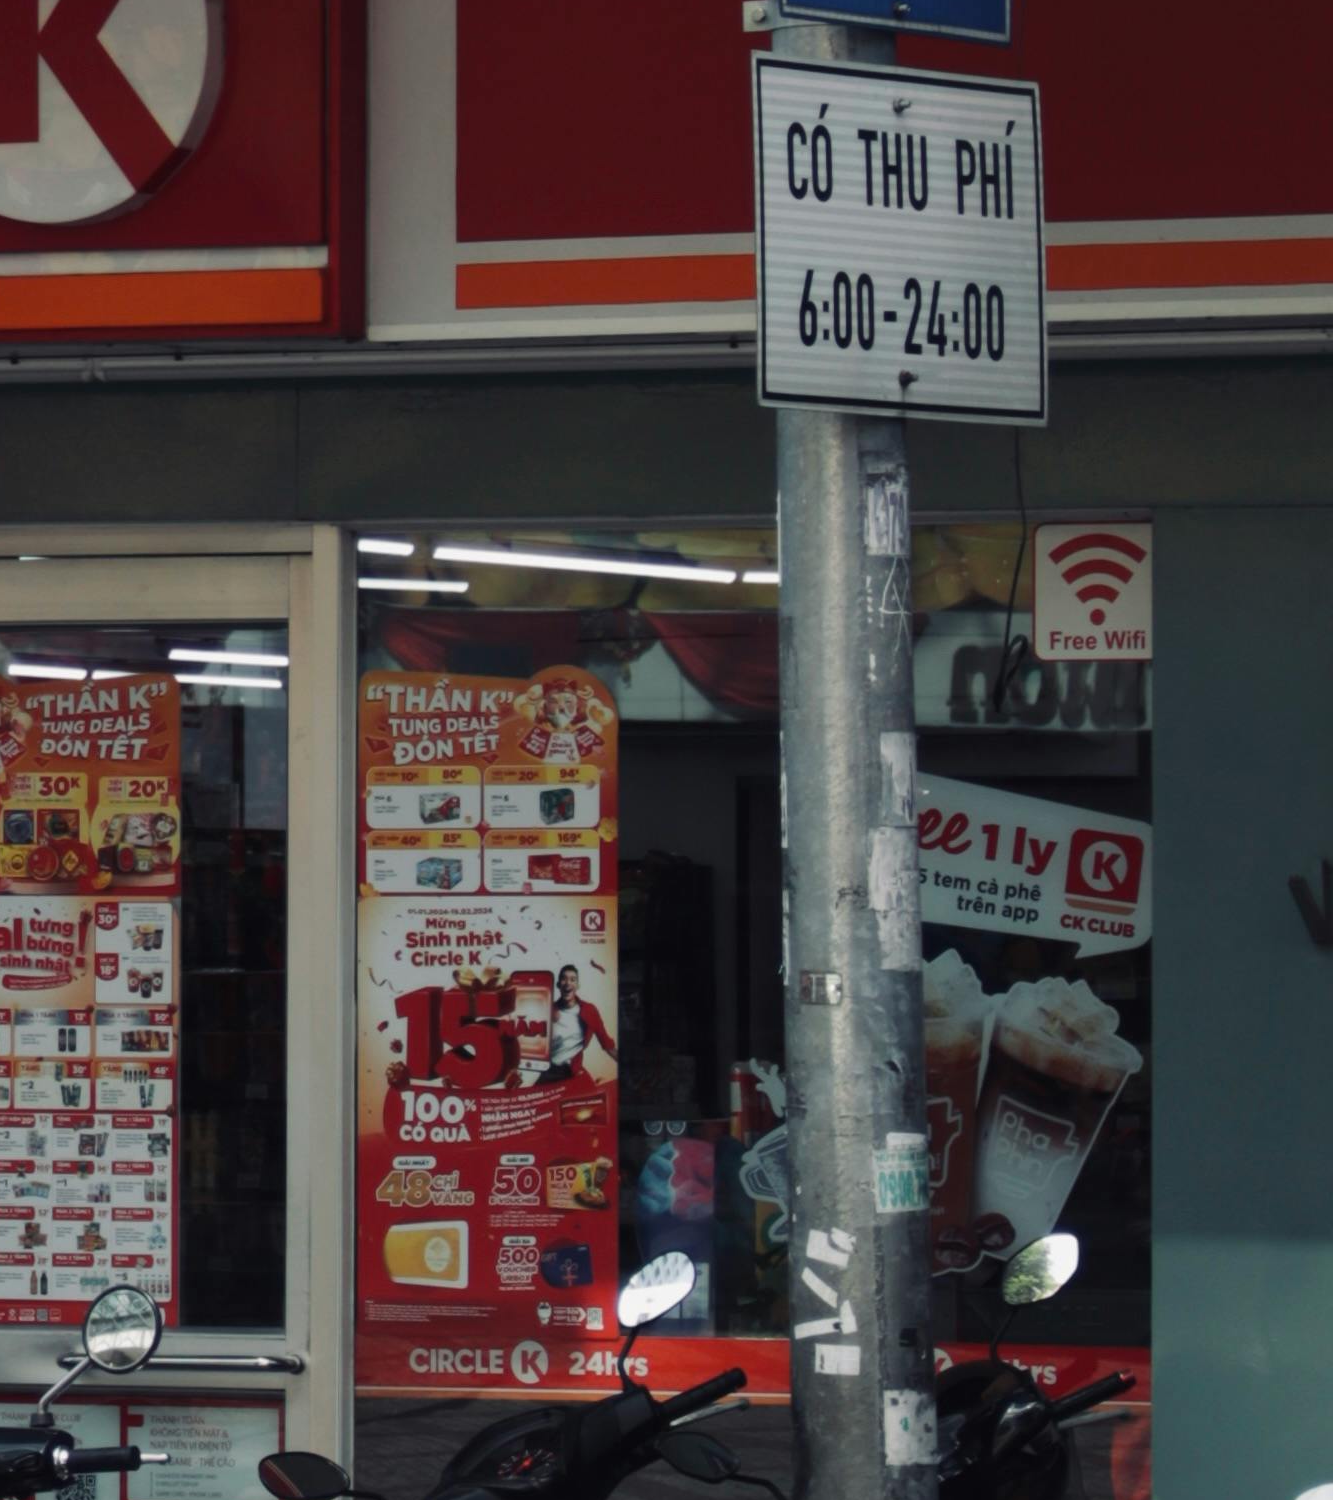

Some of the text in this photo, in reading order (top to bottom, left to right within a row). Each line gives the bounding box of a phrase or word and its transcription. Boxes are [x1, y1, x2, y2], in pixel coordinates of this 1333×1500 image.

[786, 102, 1017, 220] CÓ THU PHÍ
[797, 267, 1007, 363] 6:00-24:00
[1049, 629, 1147, 651] Free Wifi
[41, 712, 151, 735] TUNG DEALS
[388, 714, 500, 738] TUNG DEALS
[40, 725, 149, 760] ĐÓN TẾT
[393, 737, 455, 765] ĐÓN
[459, 727, 501, 755] TẾT
[38, 776, 81, 797] 30K
[127, 780, 166, 798] 20K
[917, 807, 1058, 877] ee 1 ly
[933, 871, 1042, 903] tem cà phê
[425, 916, 467, 931] Mừng
[956, 893, 1040, 924] trên app
[405, 930, 504, 950] Sinh nhật
[1059, 912, 1136, 939] CK CLUB
[0, 953, 32, 968] sinh
[410, 950, 483, 967] Circle K
[394, 986, 521, 1090] 15
[400, 1090, 477, 1125] 100%
[398, 1118, 427, 1143] CÓ
[430, 1118, 472, 1143] QUÀ
[999, 1110, 1050, 1149] Pha
[375, 1169, 434, 1208] 48
[492, 1165, 542, 1197] 50
[498, 1248, 540, 1265] 500
[408, 1347, 505, 1375] CIRCLE
[568, 1350, 650, 1380] 24hrs
